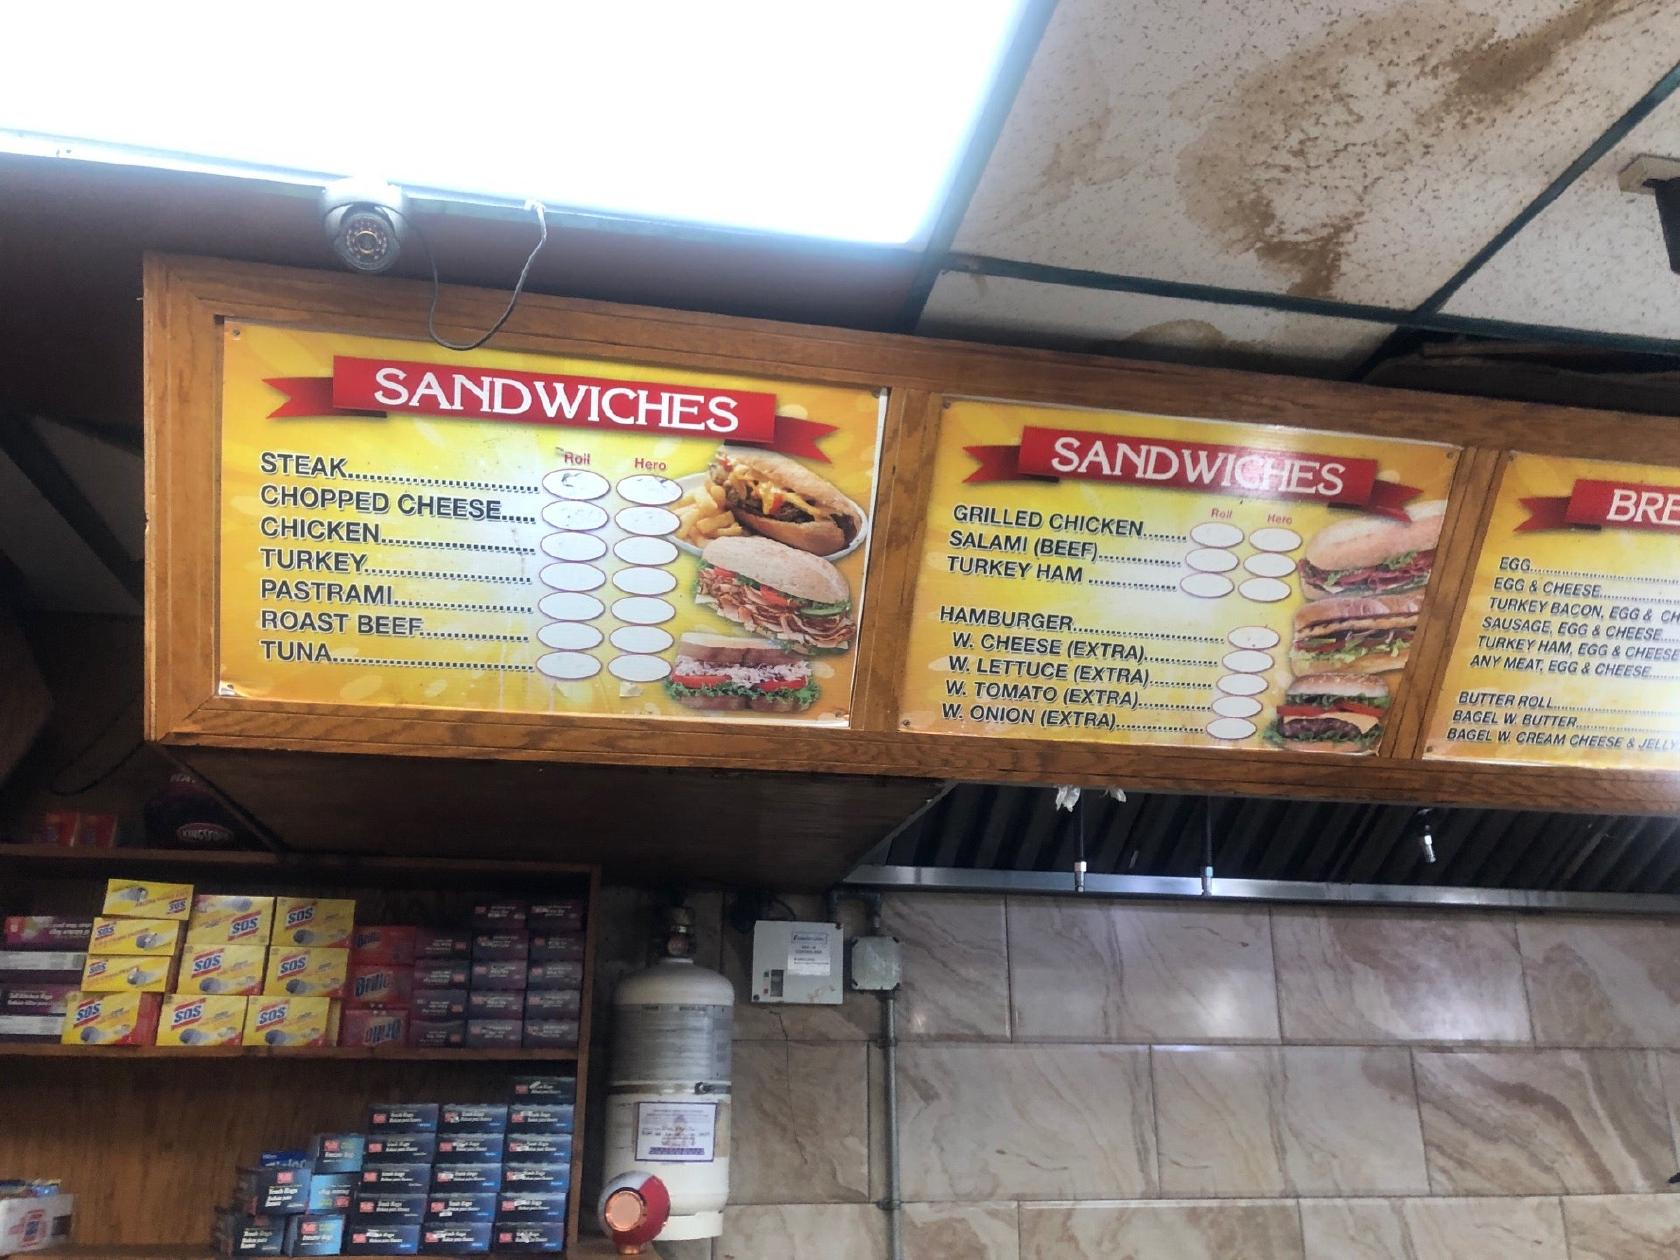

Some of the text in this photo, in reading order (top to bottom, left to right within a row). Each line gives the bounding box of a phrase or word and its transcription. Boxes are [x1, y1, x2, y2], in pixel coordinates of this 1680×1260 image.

[374, 368, 738, 432] SANDWICHES
[563, 452, 591, 465] Roll
[634, 457, 667, 471] Hero
[1051, 436, 1346, 496] SANDWICHES
[260, 485, 389, 512] CHOPPED
[953, 504, 1042, 528] GRILLED
[1210, 508, 1233, 520] Roll
[1267, 513, 1293, 525] Hero
[949, 530, 1028, 551] SALAMI
[947, 555, 1083, 582] TURKEY HAM
[1494, 577, 1525, 591] EGG
[1528, 580, 1538, 592] &
[1489, 597, 1548, 613] TURKEY
[1609, 606, 1640, 620] EGG
[1642, 608, 1653, 621] &
[261, 610, 348, 633] ROAST
[1482, 616, 1552, 635] SAUSAGE,
[1557, 622, 1588, 636] EGG
[1592, 624, 1601, 636] &
[952, 632, 973, 648] W.
[981, 634, 1061, 656] CHEESE
[1478, 635, 1535, 650] TURKEY
[1578, 643, 1608, 656] EGG
[1612, 645, 1621, 657] &
[1625, 646, 1680, 661] CHEESE
[949, 655, 970, 672] W.
[977, 657, 1067, 679] LETTUCE
[1470, 655, 1501, 668] ANY
[1548, 660, 1578, 674] EGG
[1581, 662, 1590, 674] &
[946, 679, 966, 696] W.
[974, 681, 1057, 703] TOMATO
[1459, 691, 1515, 706] BUTTER
[942, 703, 963, 719] W.
[970, 705, 1035, 725] ONION
[1453, 710, 1498, 724] BAGEL
[1504, 712, 1517, 724] W.
[1447, 728, 1492, 741] BAGEL
[1498, 731, 1511, 741] W.
[1516, 732, 1566, 744] CREAM
[1569, 734, 1624, 748] CHEESE
[1626, 737, 1635, 748] &
[288, 907, 313, 924] SOS
[232, 917, 258, 934] SOS
[194, 954, 221, 972] SOS
[280, 957, 306, 974] SOS
[76, 1004, 101, 1021] SOS
[173, 1004, 202, 1023] SOS
[259, 1006, 286, 1025] SOS
